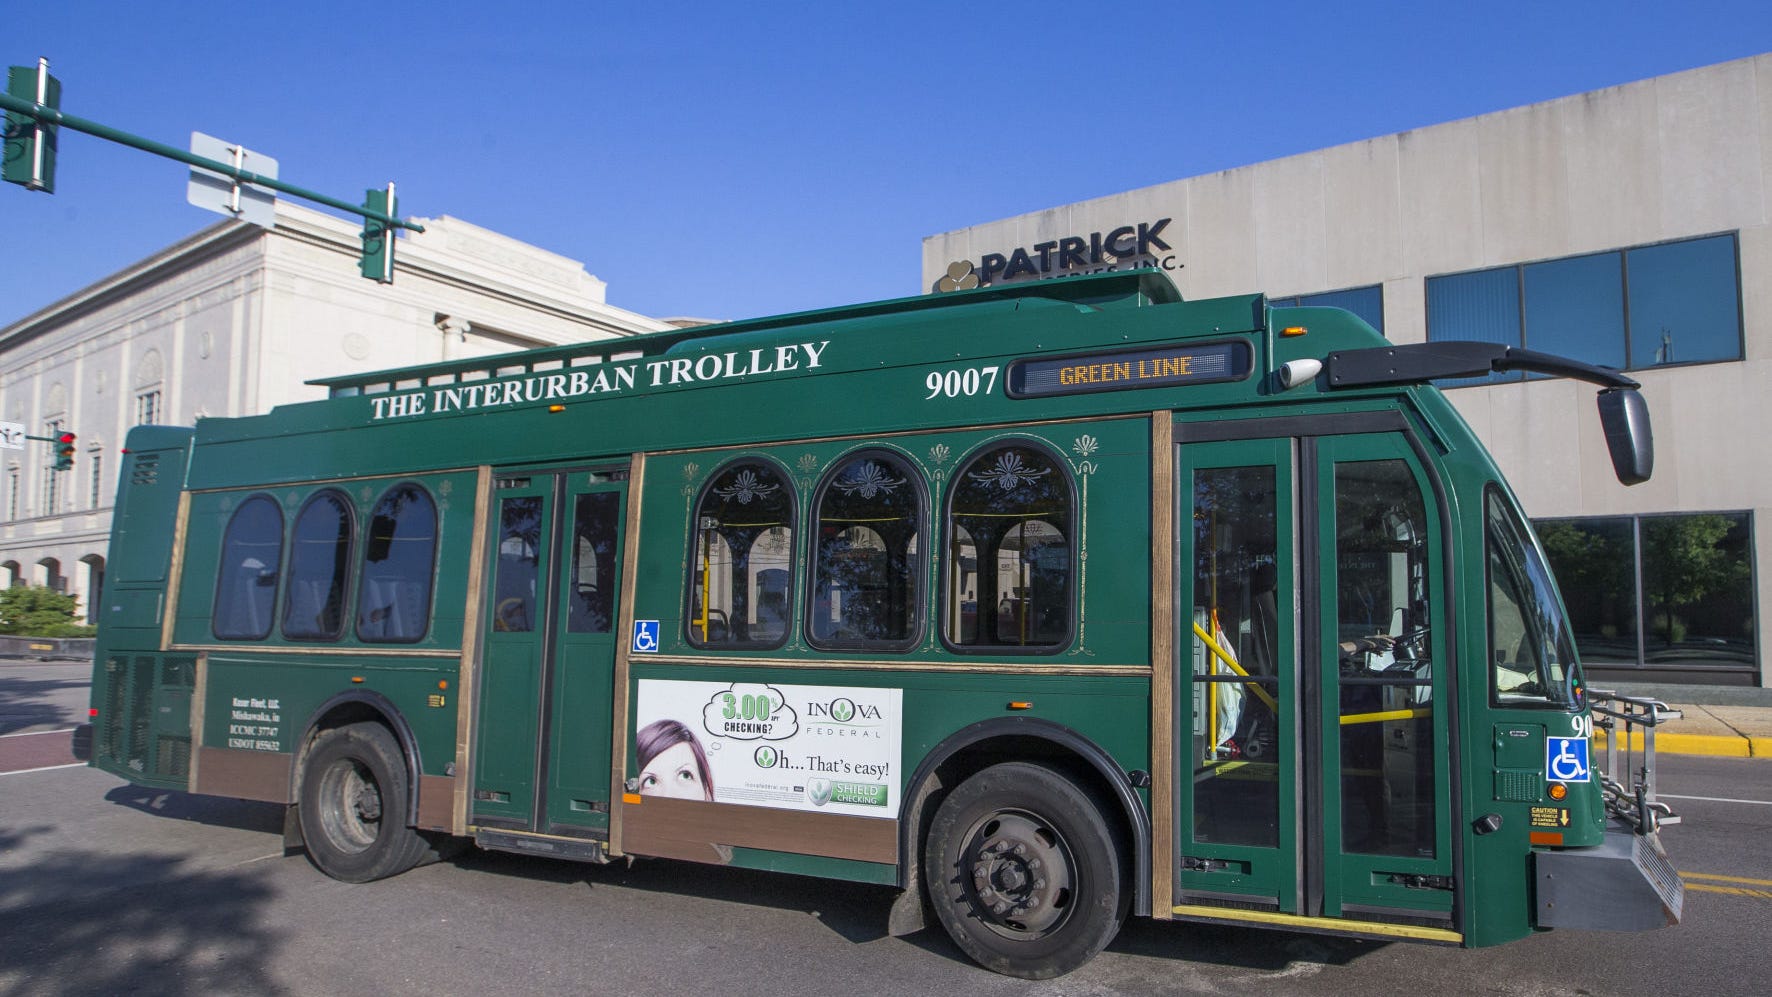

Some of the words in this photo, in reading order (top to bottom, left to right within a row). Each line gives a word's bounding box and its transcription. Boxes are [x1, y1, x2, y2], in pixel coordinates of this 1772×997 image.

[980, 218, 1172, 284] PATRICK
[371, 393, 427, 420] THE
[432, 365, 638, 413] INTERURBAN
[647, 340, 831, 387] TROLLEY
[925, 366, 999, 400] 9007
[1060, 362, 1131, 385] GREEN
[1138, 356, 1193, 378] LINE
[807, 697, 882, 722] INOVA
[724, 722, 773, 734] CHECKING?
[807, 728, 881, 738] FEDERAL
[1571, 715, 1593, 738] 90
[806, 756, 851, 773] That's
[854, 762, 889, 781] easy!
[837, 784, 878, 796] SHIELD
[837, 795, 877, 804] CHECKING
